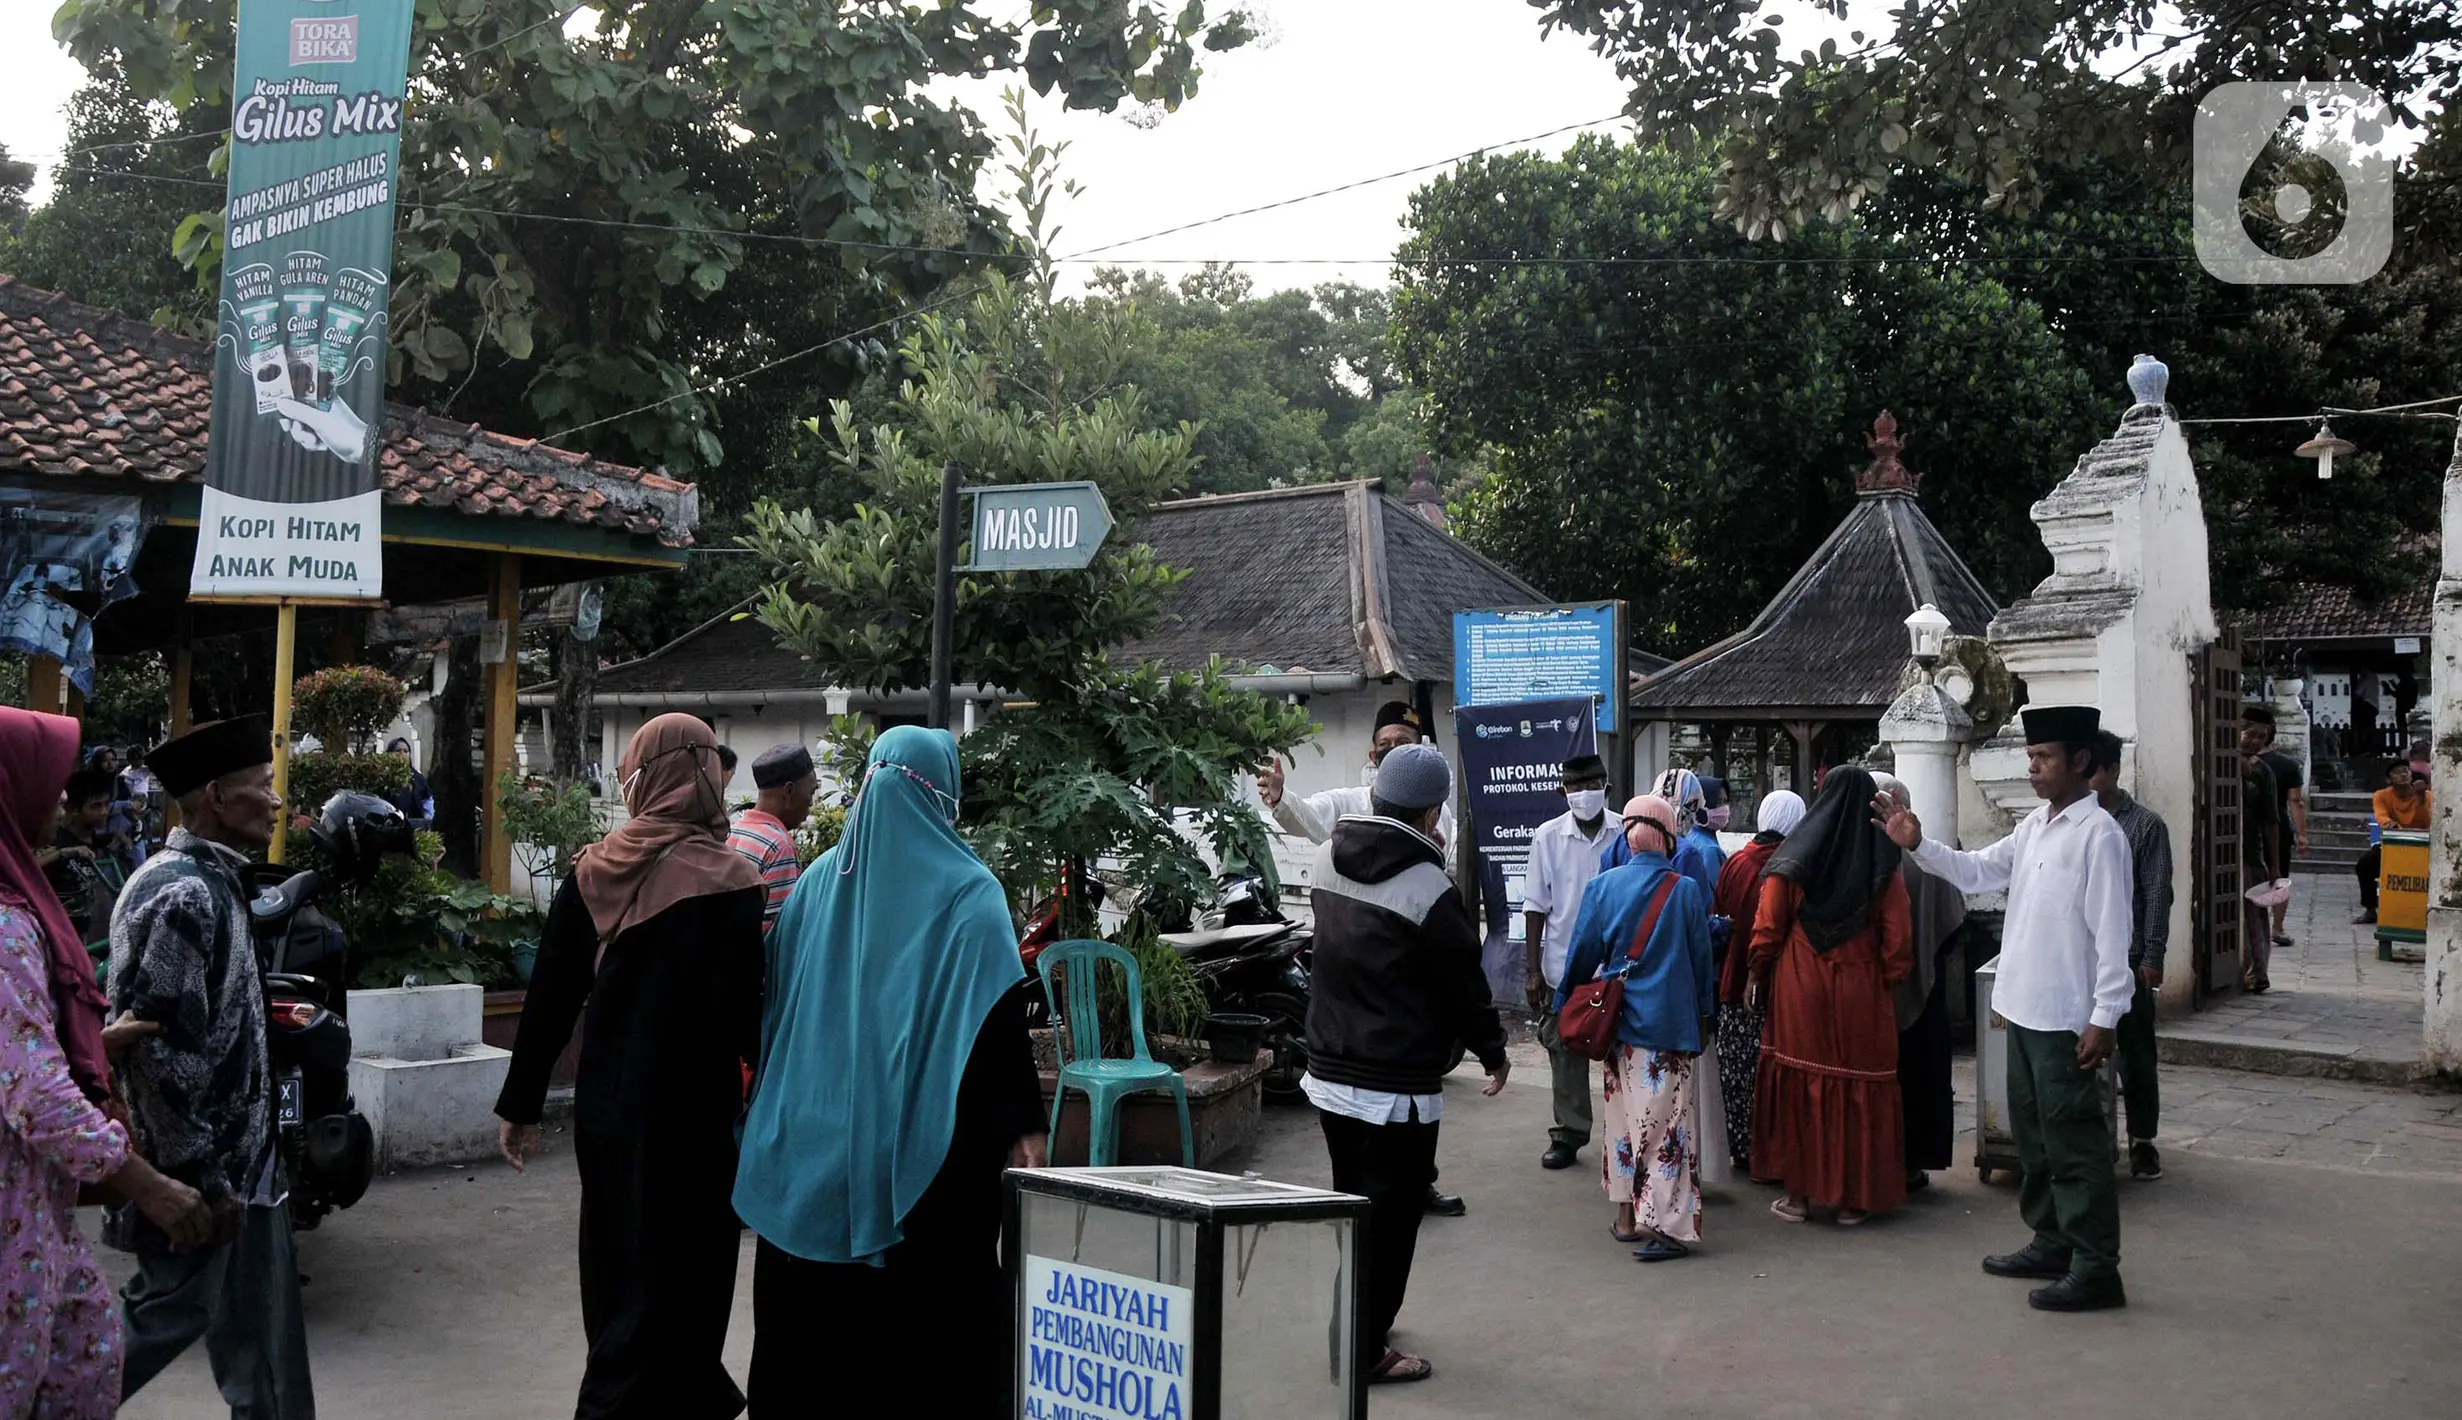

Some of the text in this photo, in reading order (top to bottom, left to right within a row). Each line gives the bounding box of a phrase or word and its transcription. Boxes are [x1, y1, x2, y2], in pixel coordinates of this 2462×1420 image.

[295, 23, 352, 40] TORA
[298, 41, 352, 57] BIKA
[254, 78, 339, 98] Kopi Hitam
[234, 94, 399, 142] Gilus Mix
[231, 152, 387, 221] AMPASNYA SUPER HALUS
[231, 181, 388, 249] GAK BIKIN KEMBUNG
[288, 258, 322, 270] HITAM
[235, 270, 270, 289] HITAM
[279, 271, 330, 286] GULA AREN
[339, 275, 376, 298] HITAM
[236, 284, 274, 302] VANILLA
[333, 288, 373, 312] PANDAN
[248, 322, 278, 340] Gilus
[287, 316, 318, 333] Gilus
[323, 327, 354, 345] Gilus
[219, 515, 361, 542] KOPI HITAM
[983, 506, 1079, 551] MASJID
[209, 554, 358, 581] ANAK MUDA
[1483, 783, 1529, 794] PROTOKOL
[1046, 1270, 1169, 1332] JARIYAH
[1032, 1306, 1184, 1378] PEMBANGUNAN
[1029, 1344, 1183, 1420] MUSHOLA
